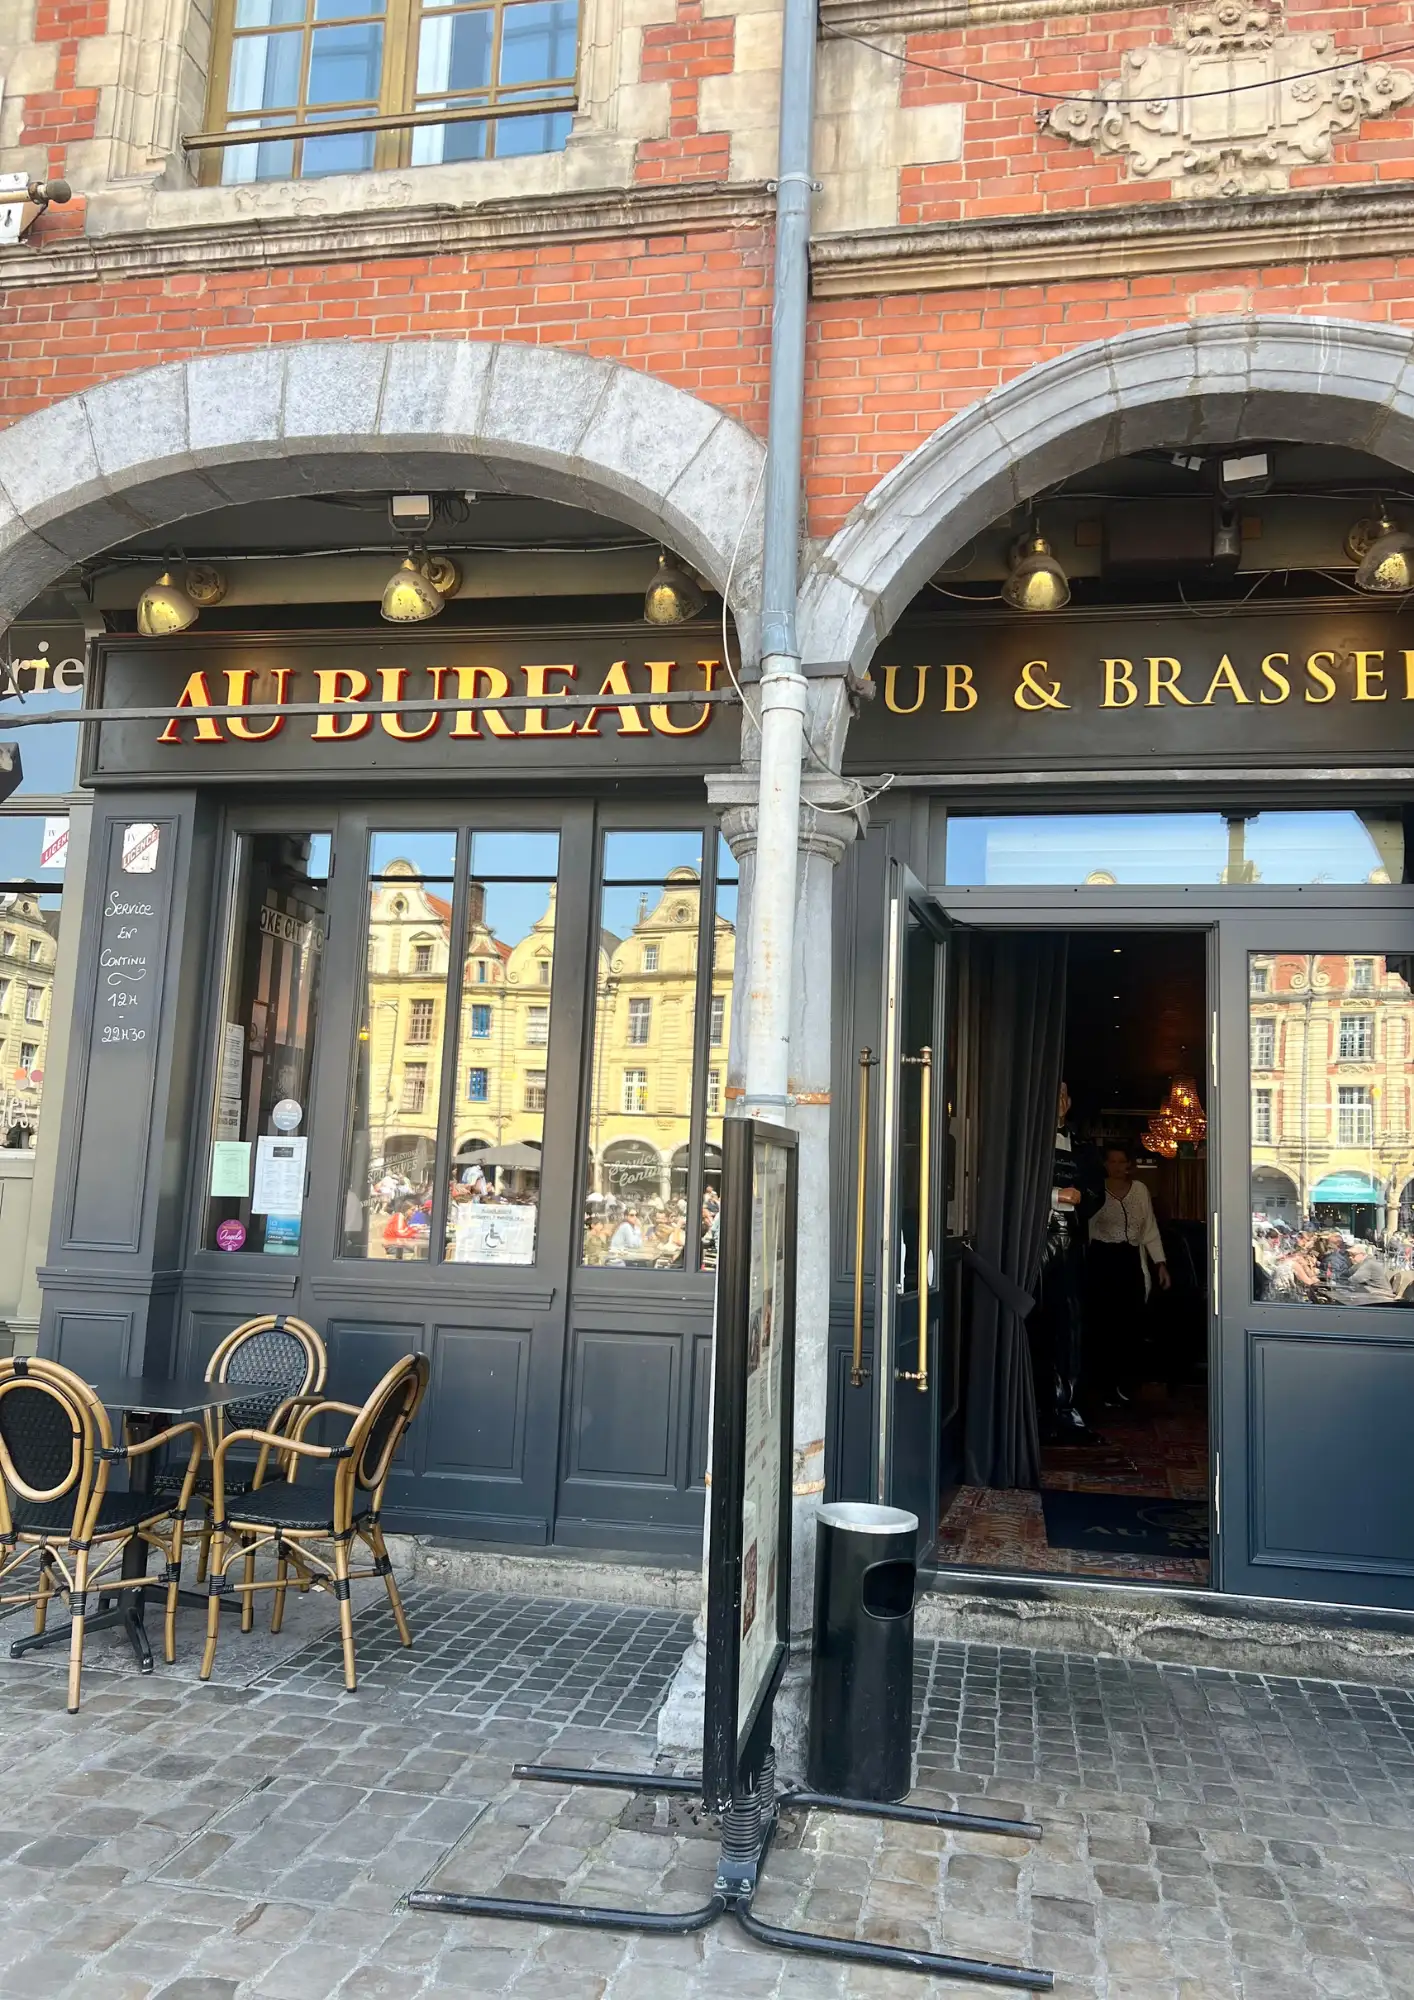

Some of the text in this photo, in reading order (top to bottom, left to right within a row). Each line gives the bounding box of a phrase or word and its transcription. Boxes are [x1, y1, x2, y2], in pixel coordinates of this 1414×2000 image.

[157, 660, 720, 743] AU BUREAU
[864, 664, 978, 713] UB
[1013, 660, 1071, 711] &
[124, 829, 159, 868] LICENCE
[105, 890, 154, 916] Service
